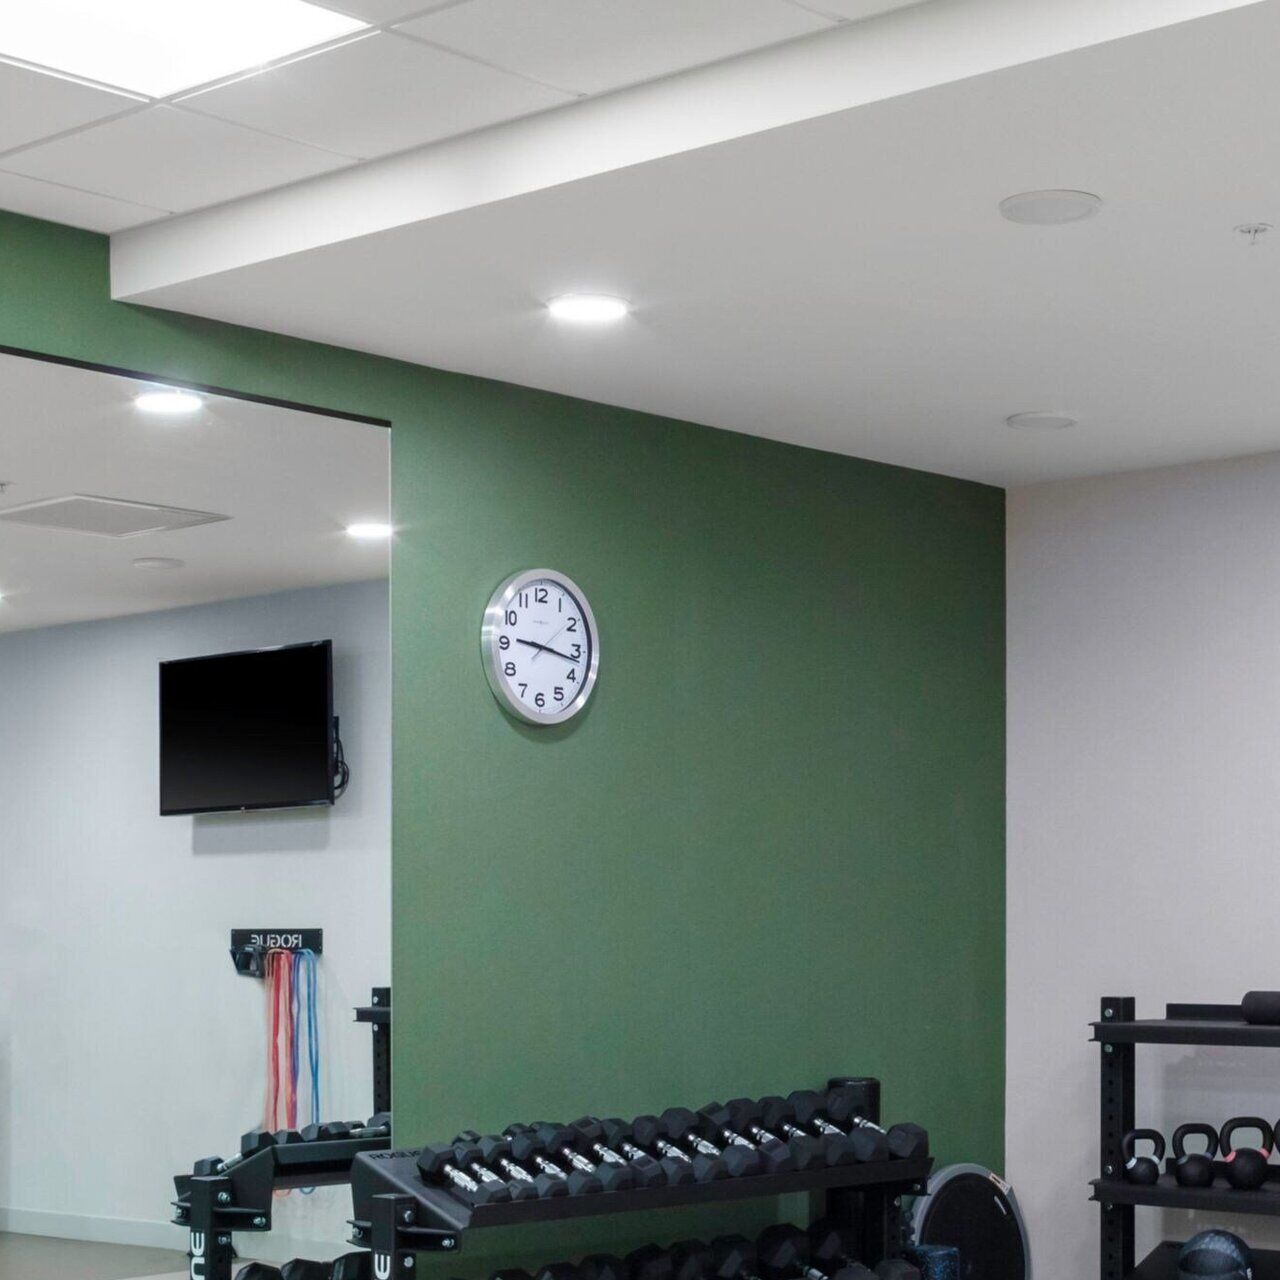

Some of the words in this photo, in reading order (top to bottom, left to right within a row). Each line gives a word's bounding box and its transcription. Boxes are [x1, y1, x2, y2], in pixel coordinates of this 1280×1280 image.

[519, 593, 529, 608] 11
[534, 587, 549, 604] 12
[558, 597, 562, 612] 1
[505, 610, 518, 626] 10
[566, 617, 577, 632] 2
[499, 635, 510, 650] 9
[570, 643, 581, 659] 3
[504, 662, 516, 677] 8
[566, 668, 576, 683] 4
[518, 683, 528, 698] 7
[553, 687, 564, 701] 5
[534, 693, 546, 707] 6
